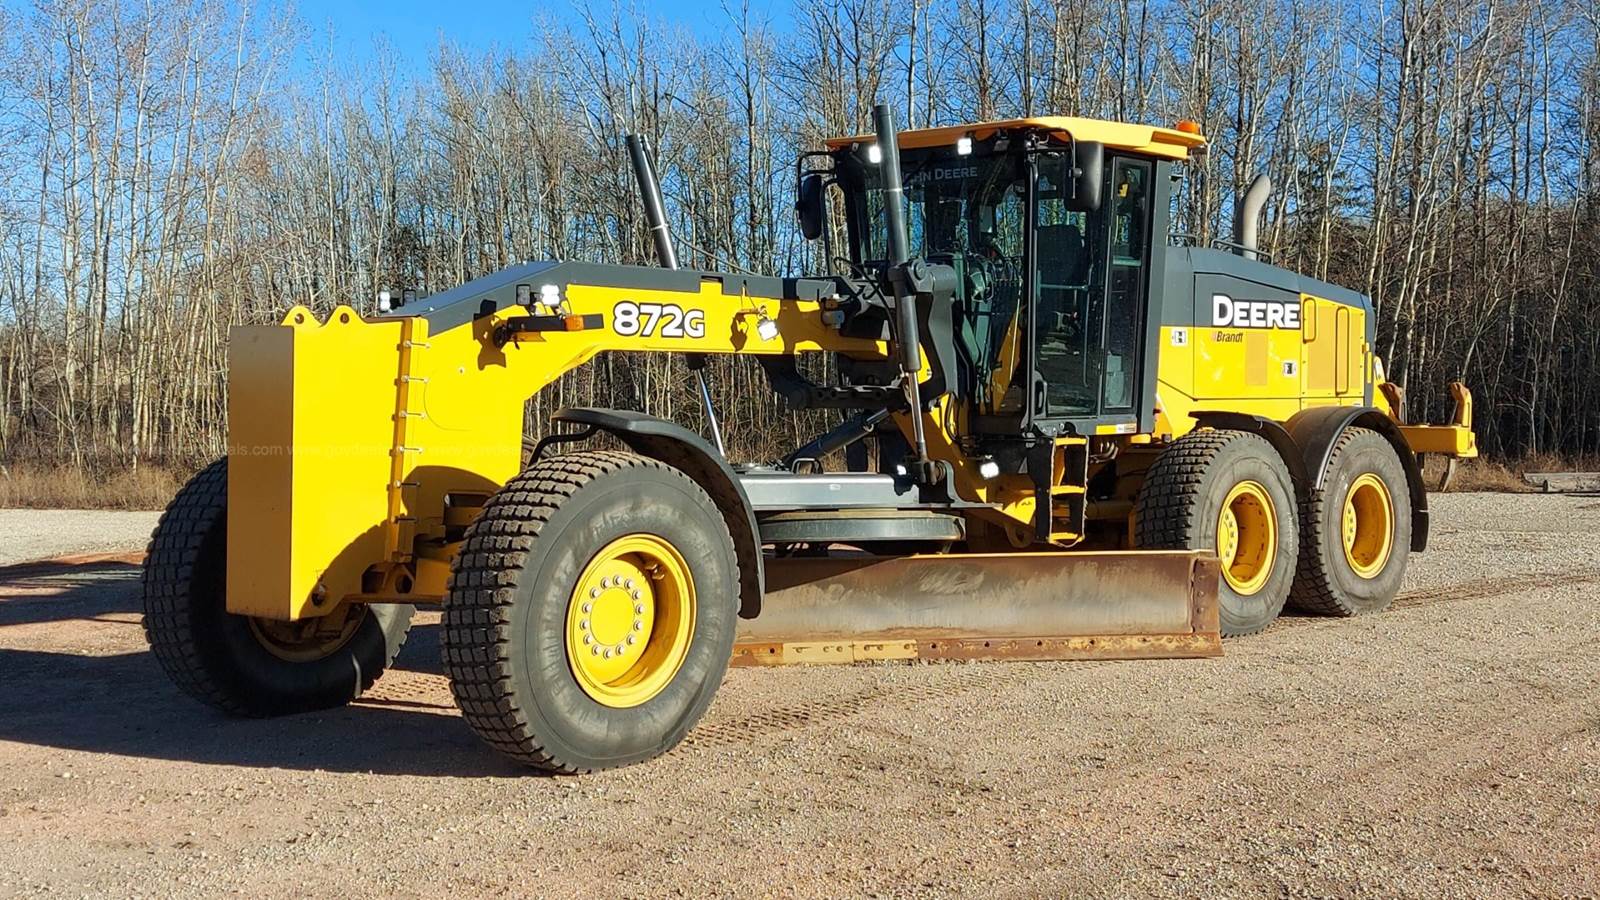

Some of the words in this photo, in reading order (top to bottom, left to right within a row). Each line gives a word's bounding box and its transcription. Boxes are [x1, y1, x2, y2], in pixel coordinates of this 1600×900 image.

[934, 166, 978, 180] DEERE
[613, 300, 705, 338] 872G
[1212, 293, 1300, 329] DEERE
[1216, 331, 1244, 343] Brandt
